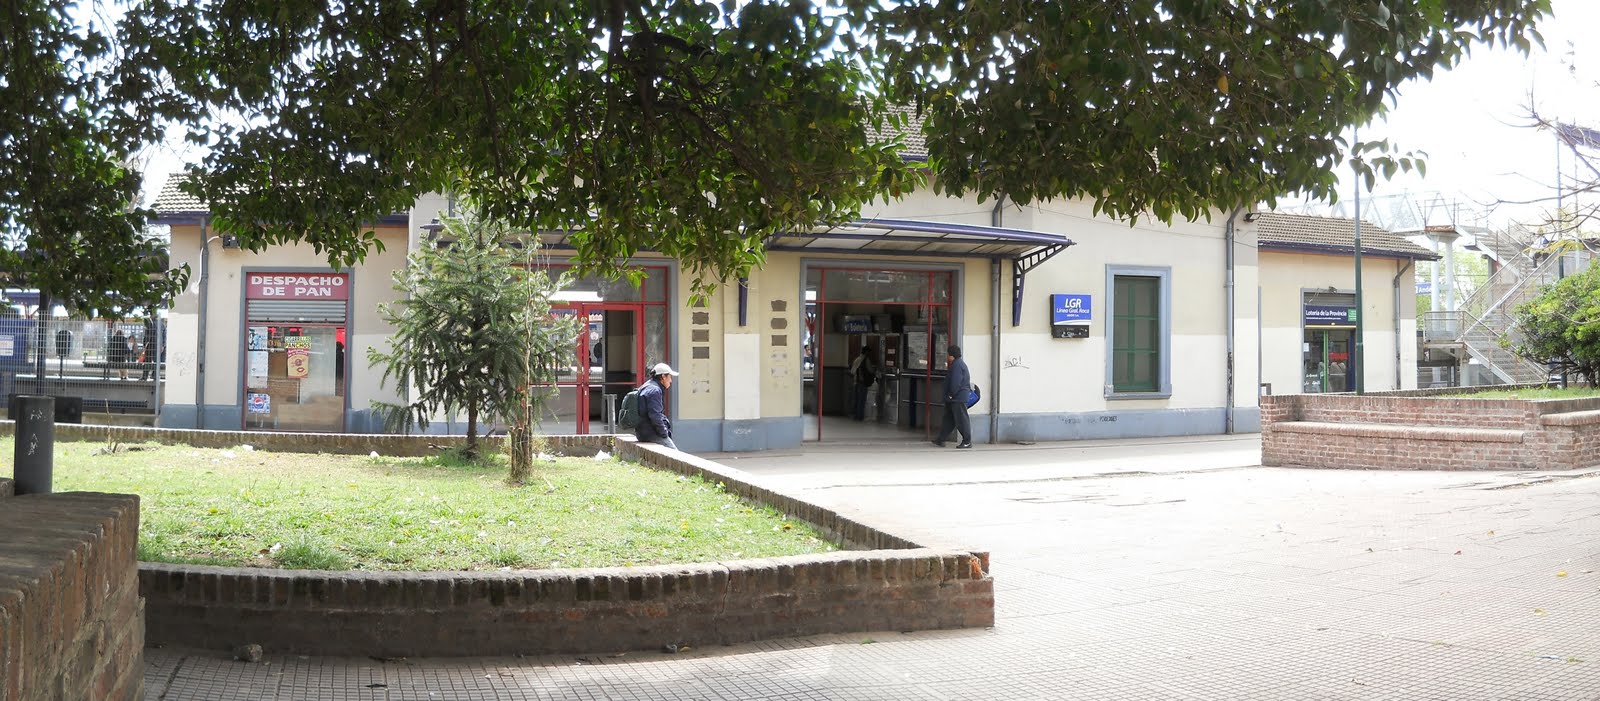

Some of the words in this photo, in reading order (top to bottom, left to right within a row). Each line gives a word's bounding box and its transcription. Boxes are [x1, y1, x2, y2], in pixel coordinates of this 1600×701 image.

[251, 276, 344, 286] DESPACHO
[262, 287, 285, 296] DE
[294, 287, 332, 296] PAN
[1065, 298, 1081, 308] LGR
